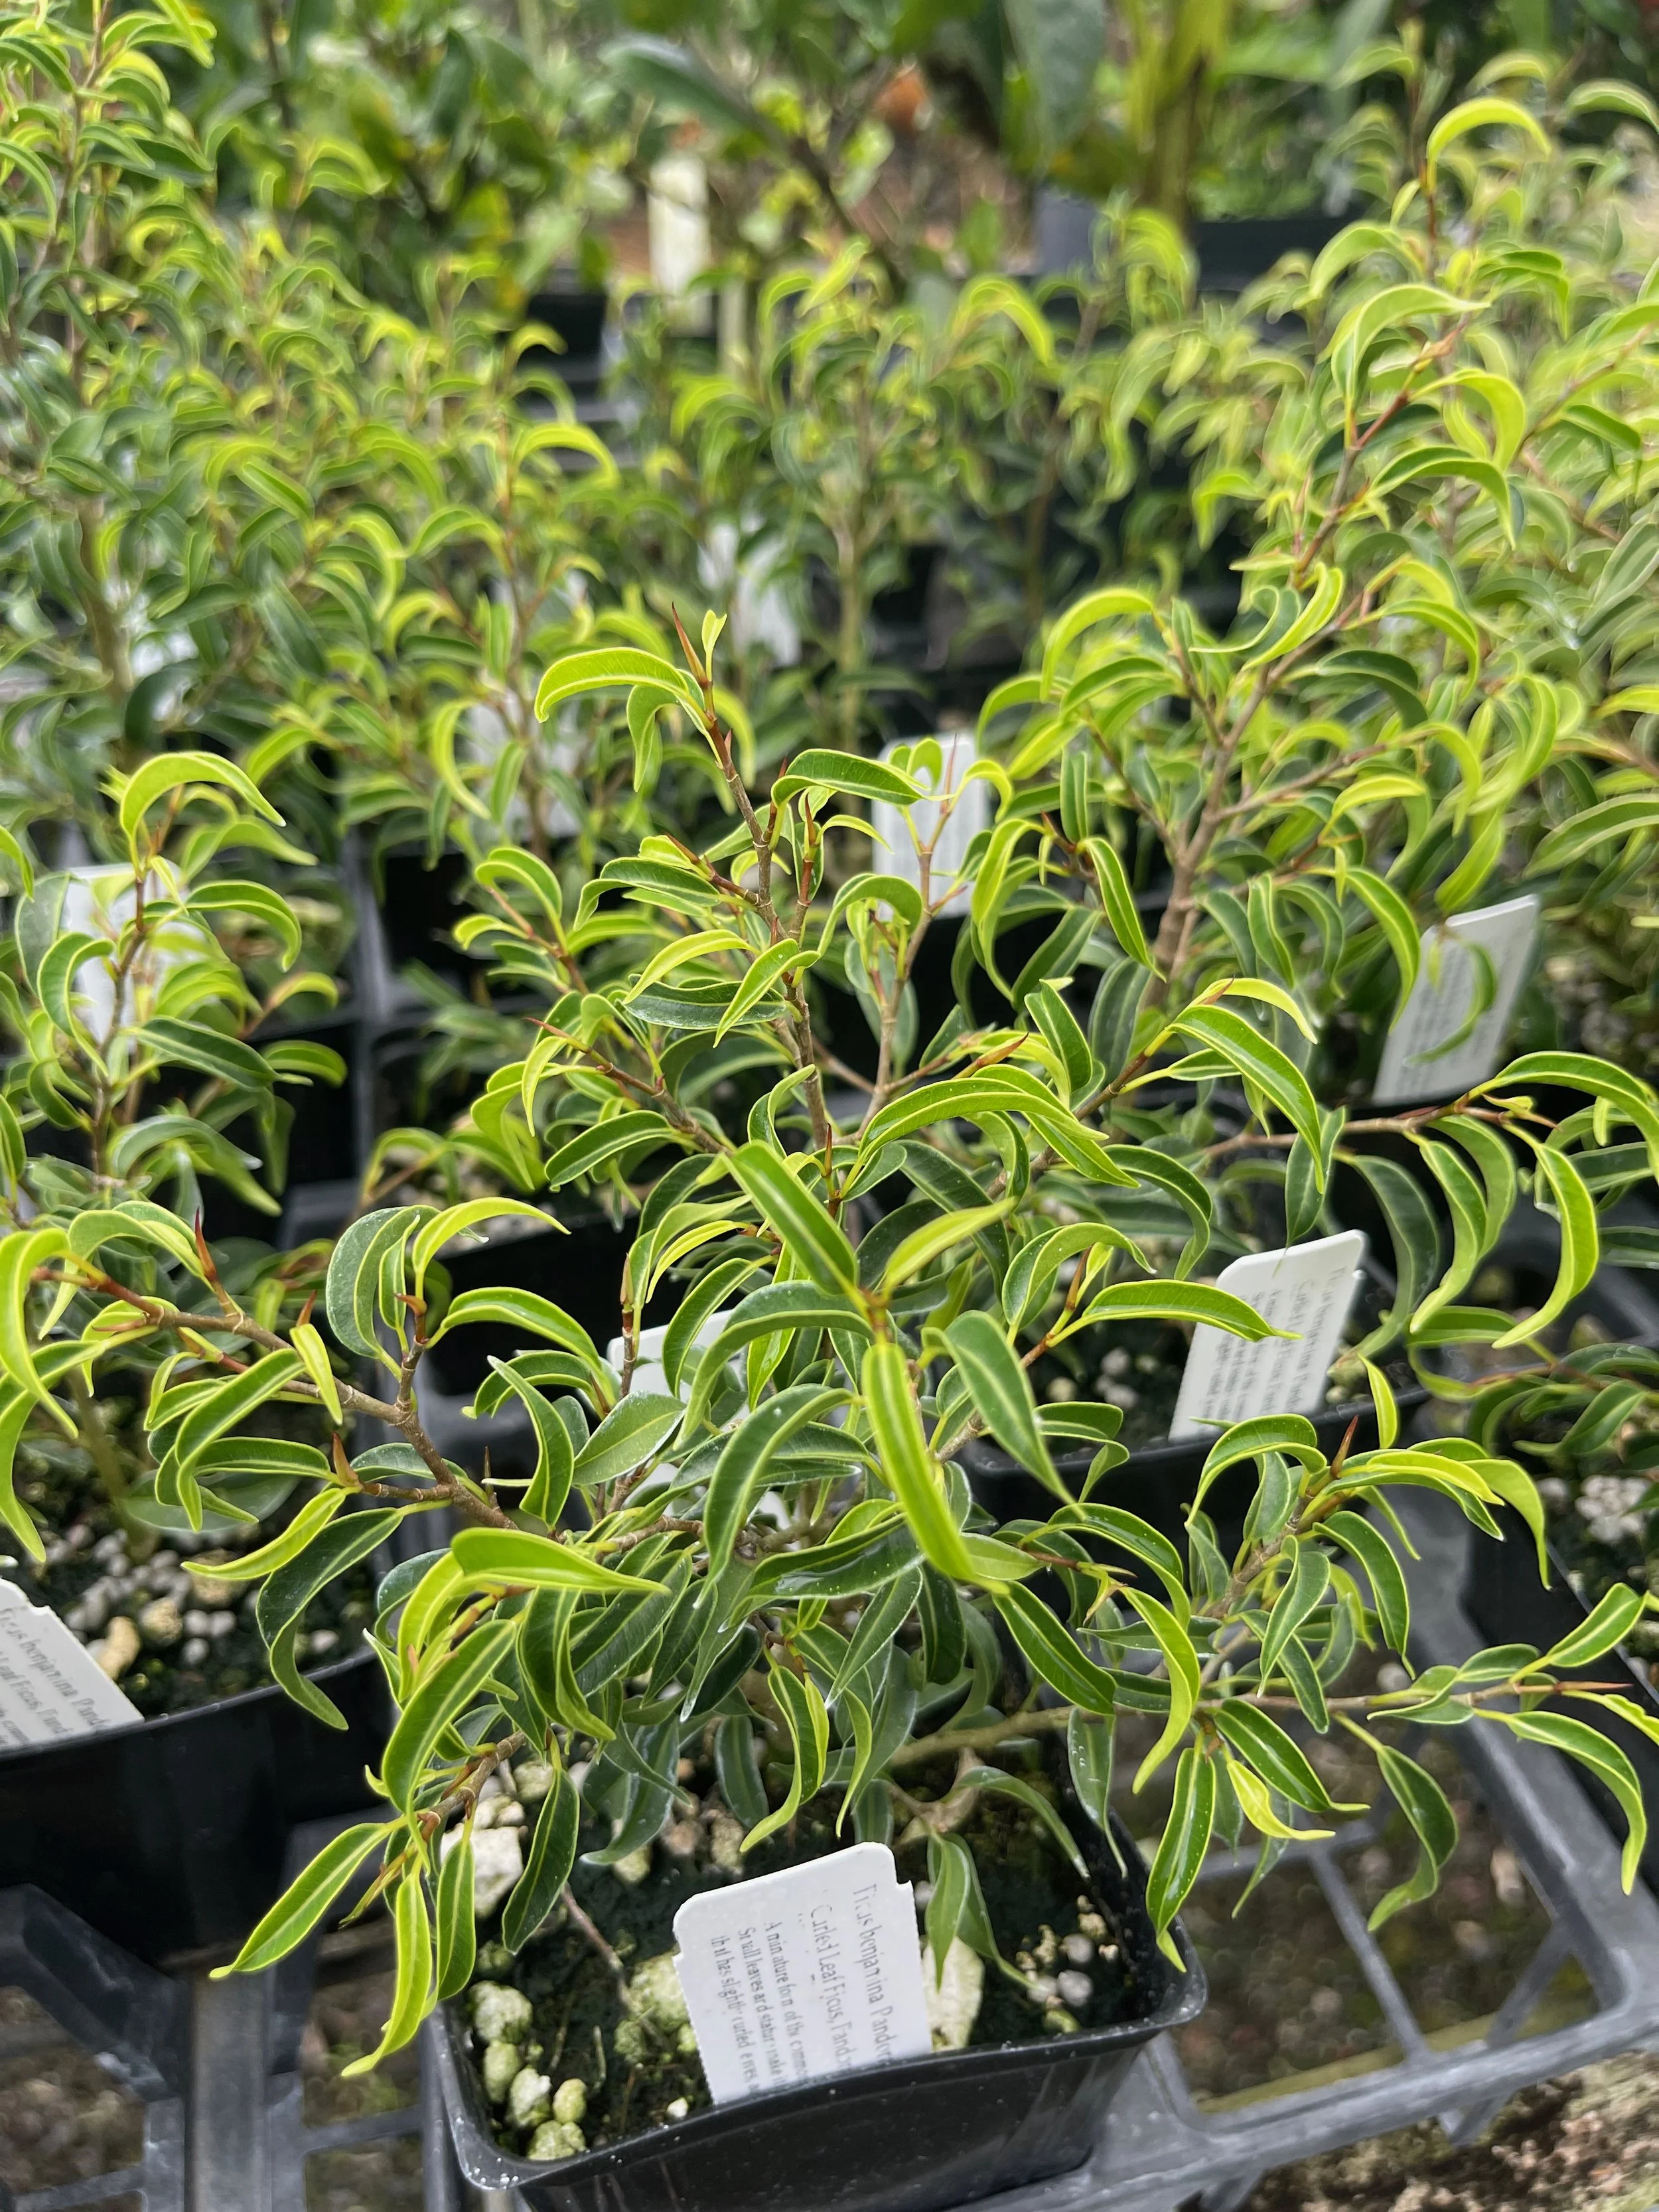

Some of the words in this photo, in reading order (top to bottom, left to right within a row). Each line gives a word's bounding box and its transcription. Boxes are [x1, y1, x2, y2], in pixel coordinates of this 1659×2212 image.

[764, 1921, 782, 1931] A
[716, 1956, 735, 1977] has
[766, 1932, 790, 1982] minature
[819, 1951, 845, 1984] Leaf
[853, 1924, 888, 2004] benjamina
[745, 1958, 764, 1992] leaves
[783, 2010, 802, 2022] of
